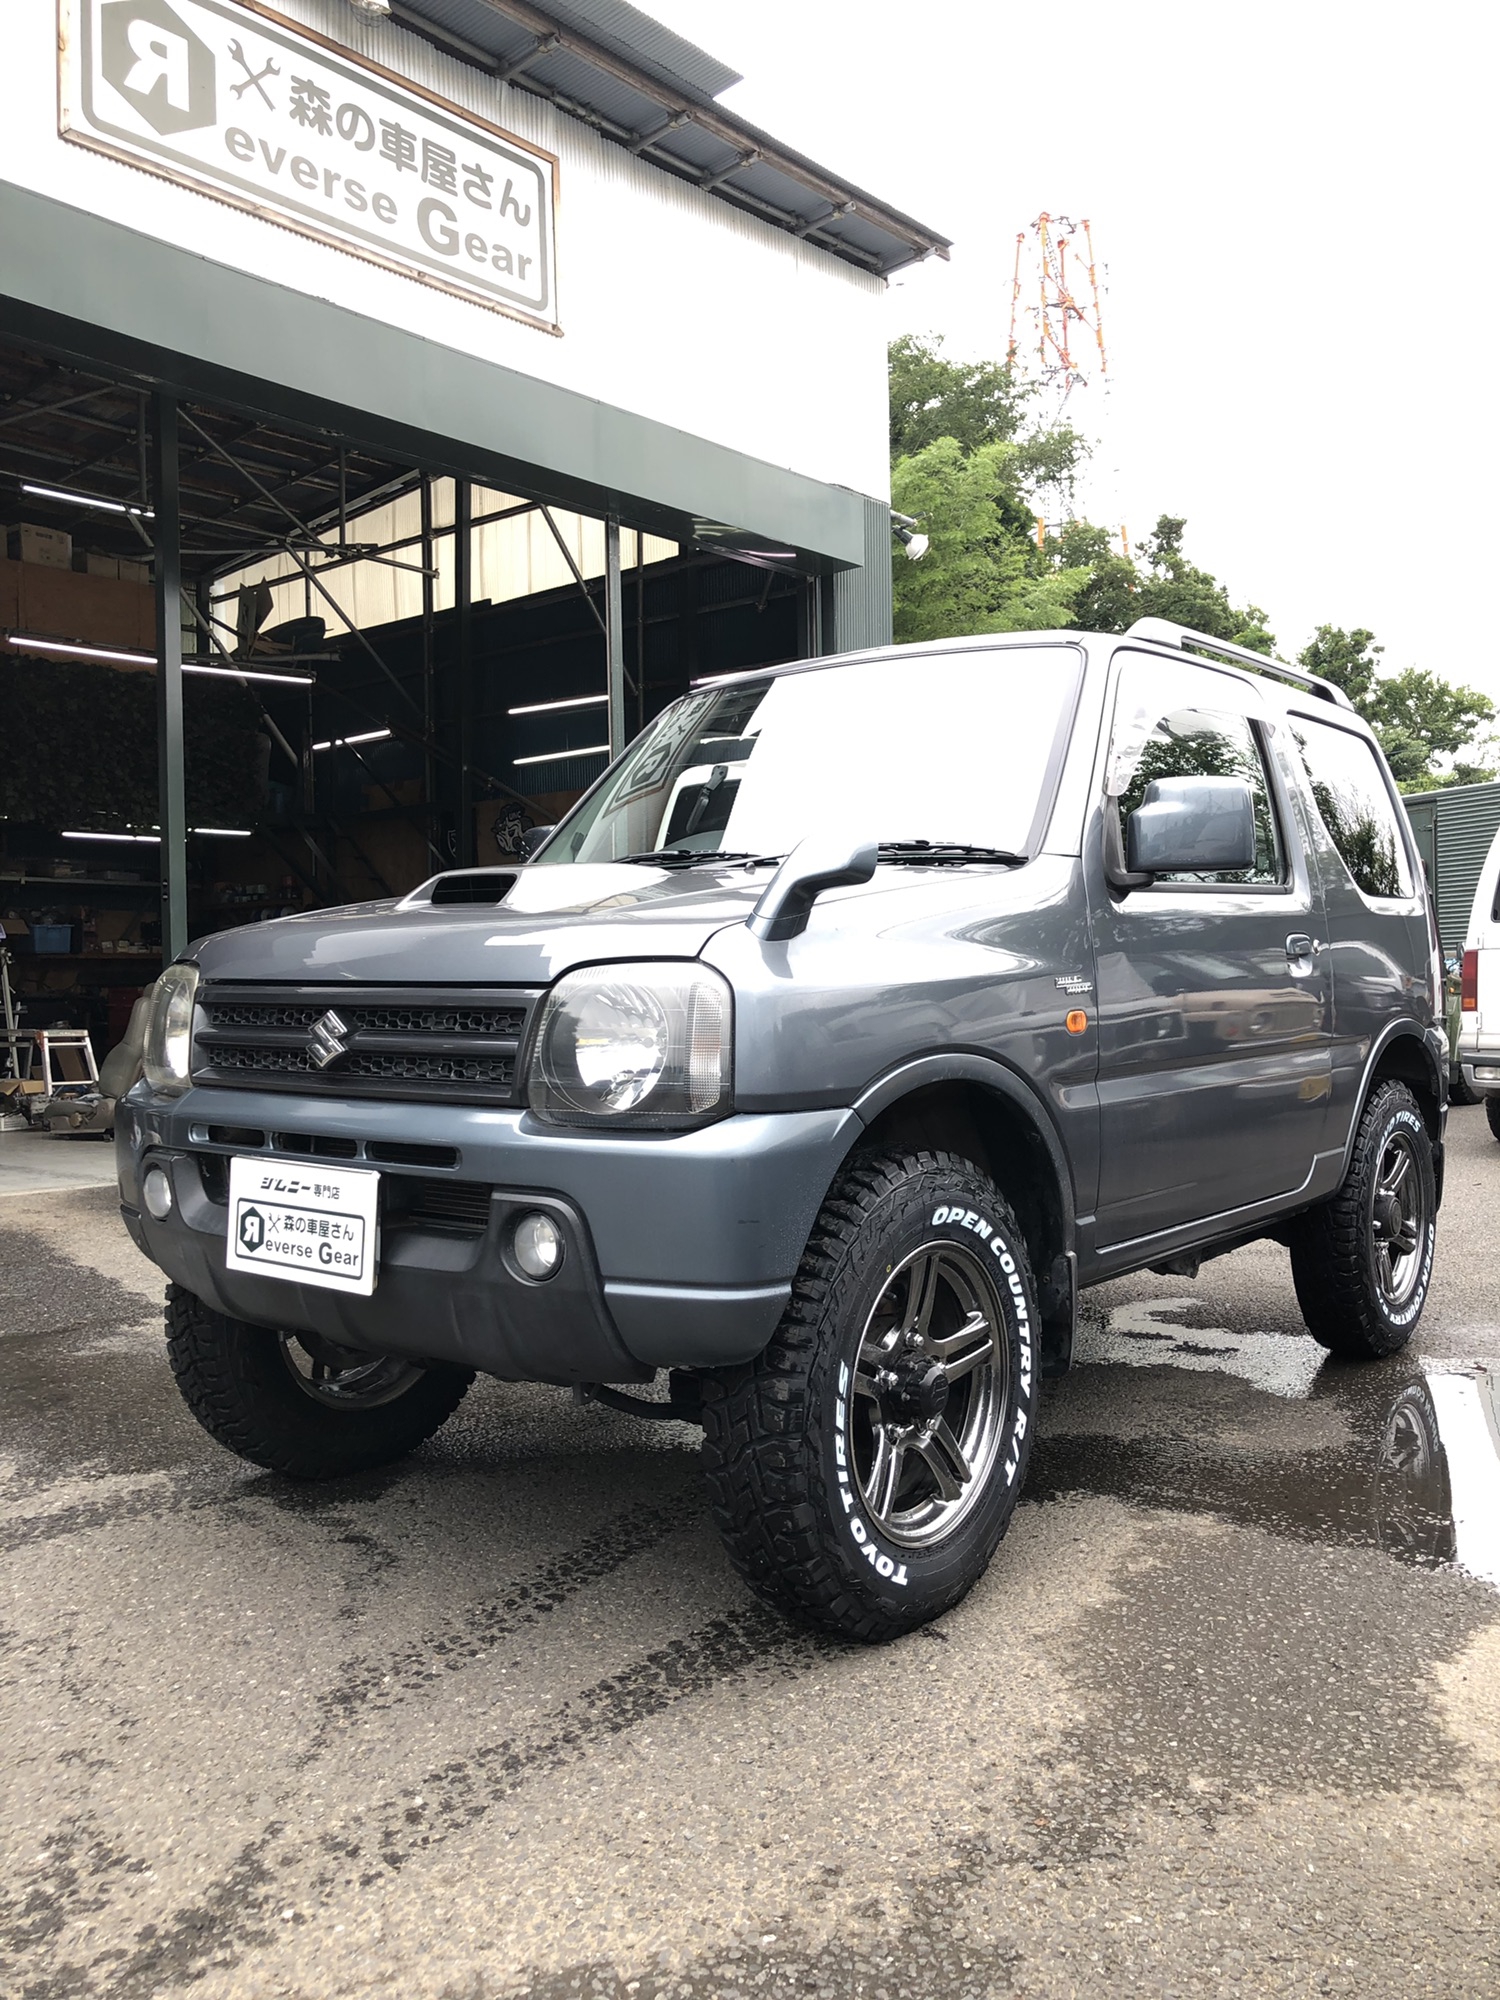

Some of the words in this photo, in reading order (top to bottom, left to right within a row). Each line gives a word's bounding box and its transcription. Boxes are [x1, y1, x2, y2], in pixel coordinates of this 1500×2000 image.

[288, 75, 531, 227] 森の車屋さん
[225, 126, 398, 224] everse
[416, 196, 533, 282] Gear
[1396, 1110, 1421, 1133] TIRES
[265, 1239, 313, 1258] everse
[318, 1242, 359, 1266] Gear
[283, 1214, 354, 1241] 森の車屋さん
[931, 1205, 993, 1240] OPEN
[1422, 1222, 1435, 1287] OPEN
[990, 1237, 1032, 1399] COUNTRY
[1390, 1285, 1424, 1325] COUNTRY
[835, 1360, 854, 1514] TIRES
[1004, 1407, 1027, 1487] R/T
[850, 1517, 908, 1586] TOYO
